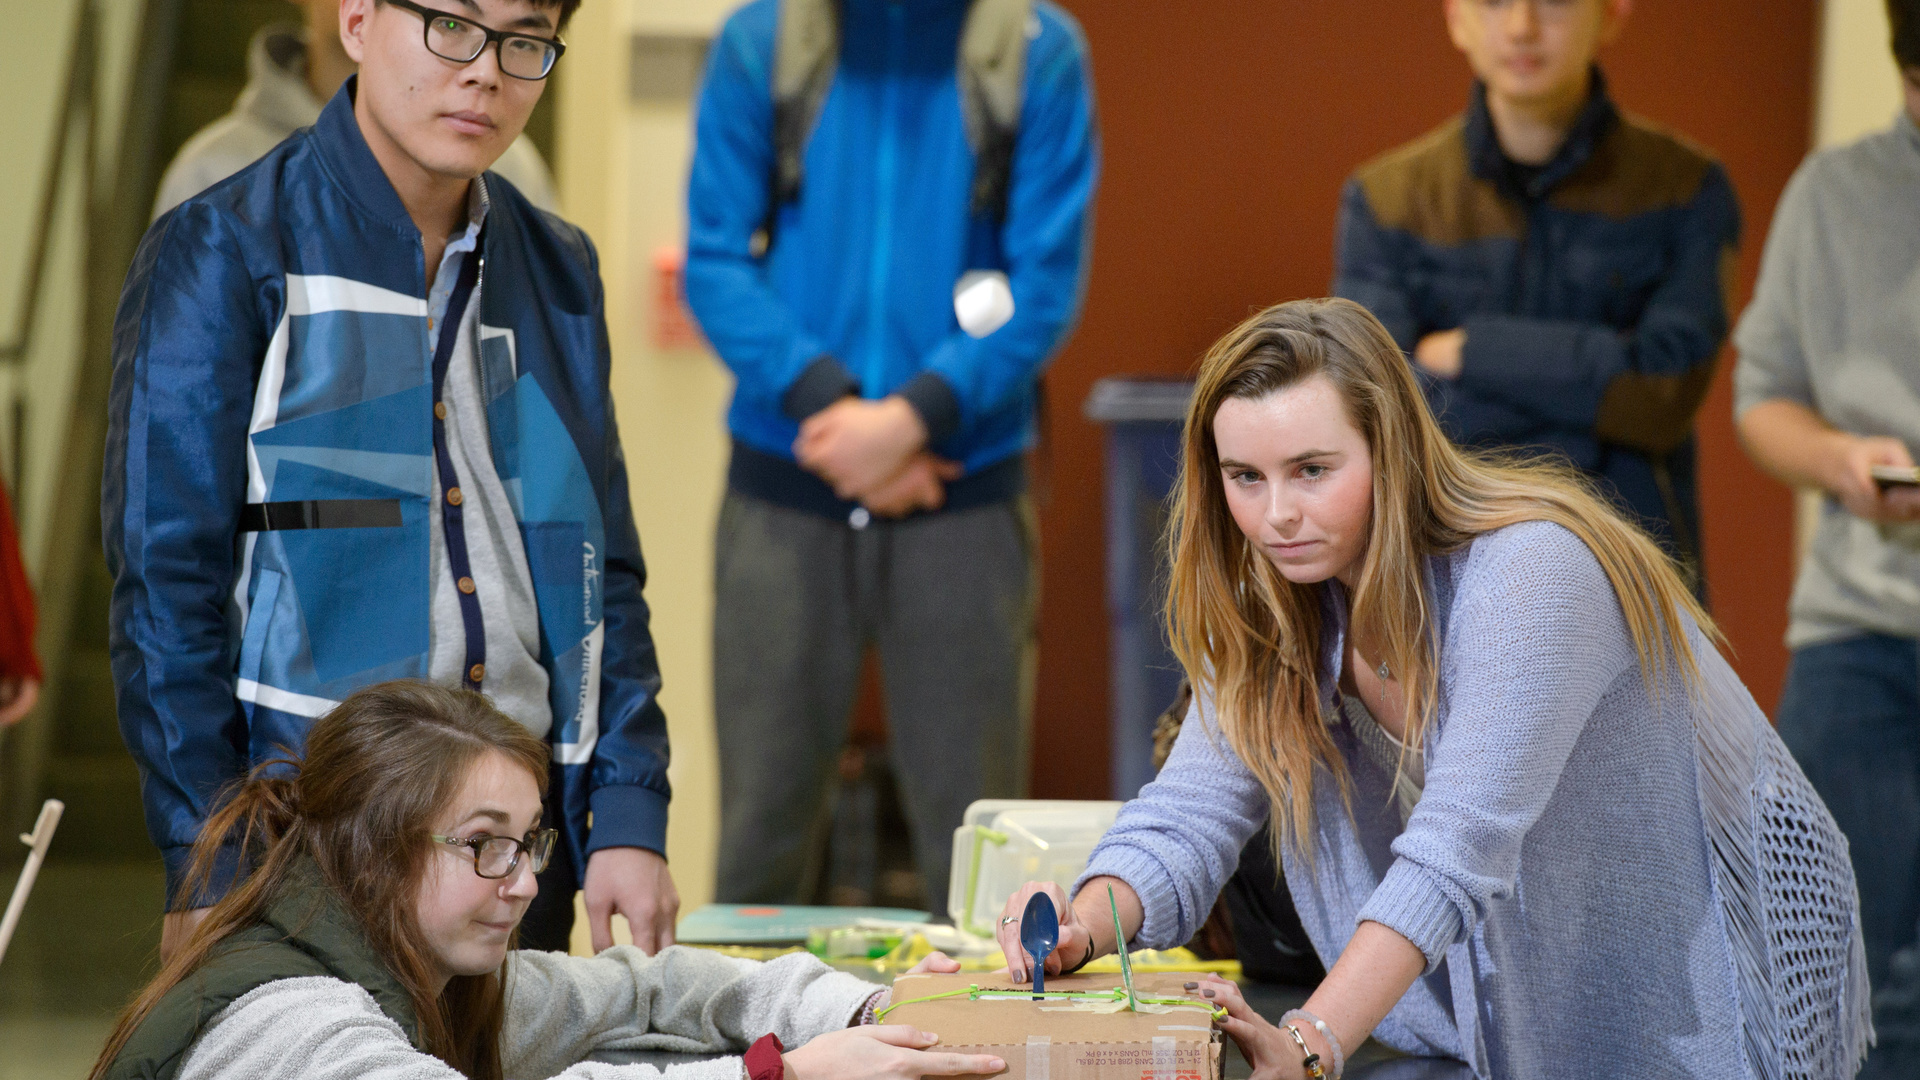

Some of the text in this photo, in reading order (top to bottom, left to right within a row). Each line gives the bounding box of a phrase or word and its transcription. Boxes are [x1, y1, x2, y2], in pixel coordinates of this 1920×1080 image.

[1119, 1050, 1139, 1058] CANS
[1095, 1057, 1107, 1065] OZ
[1108, 1057, 1116, 1065] FL
[1135, 1057, 1154, 1065] CANS
[1156, 1057, 1167, 1065] OZ
[1168, 1057, 1176, 1065] FL
